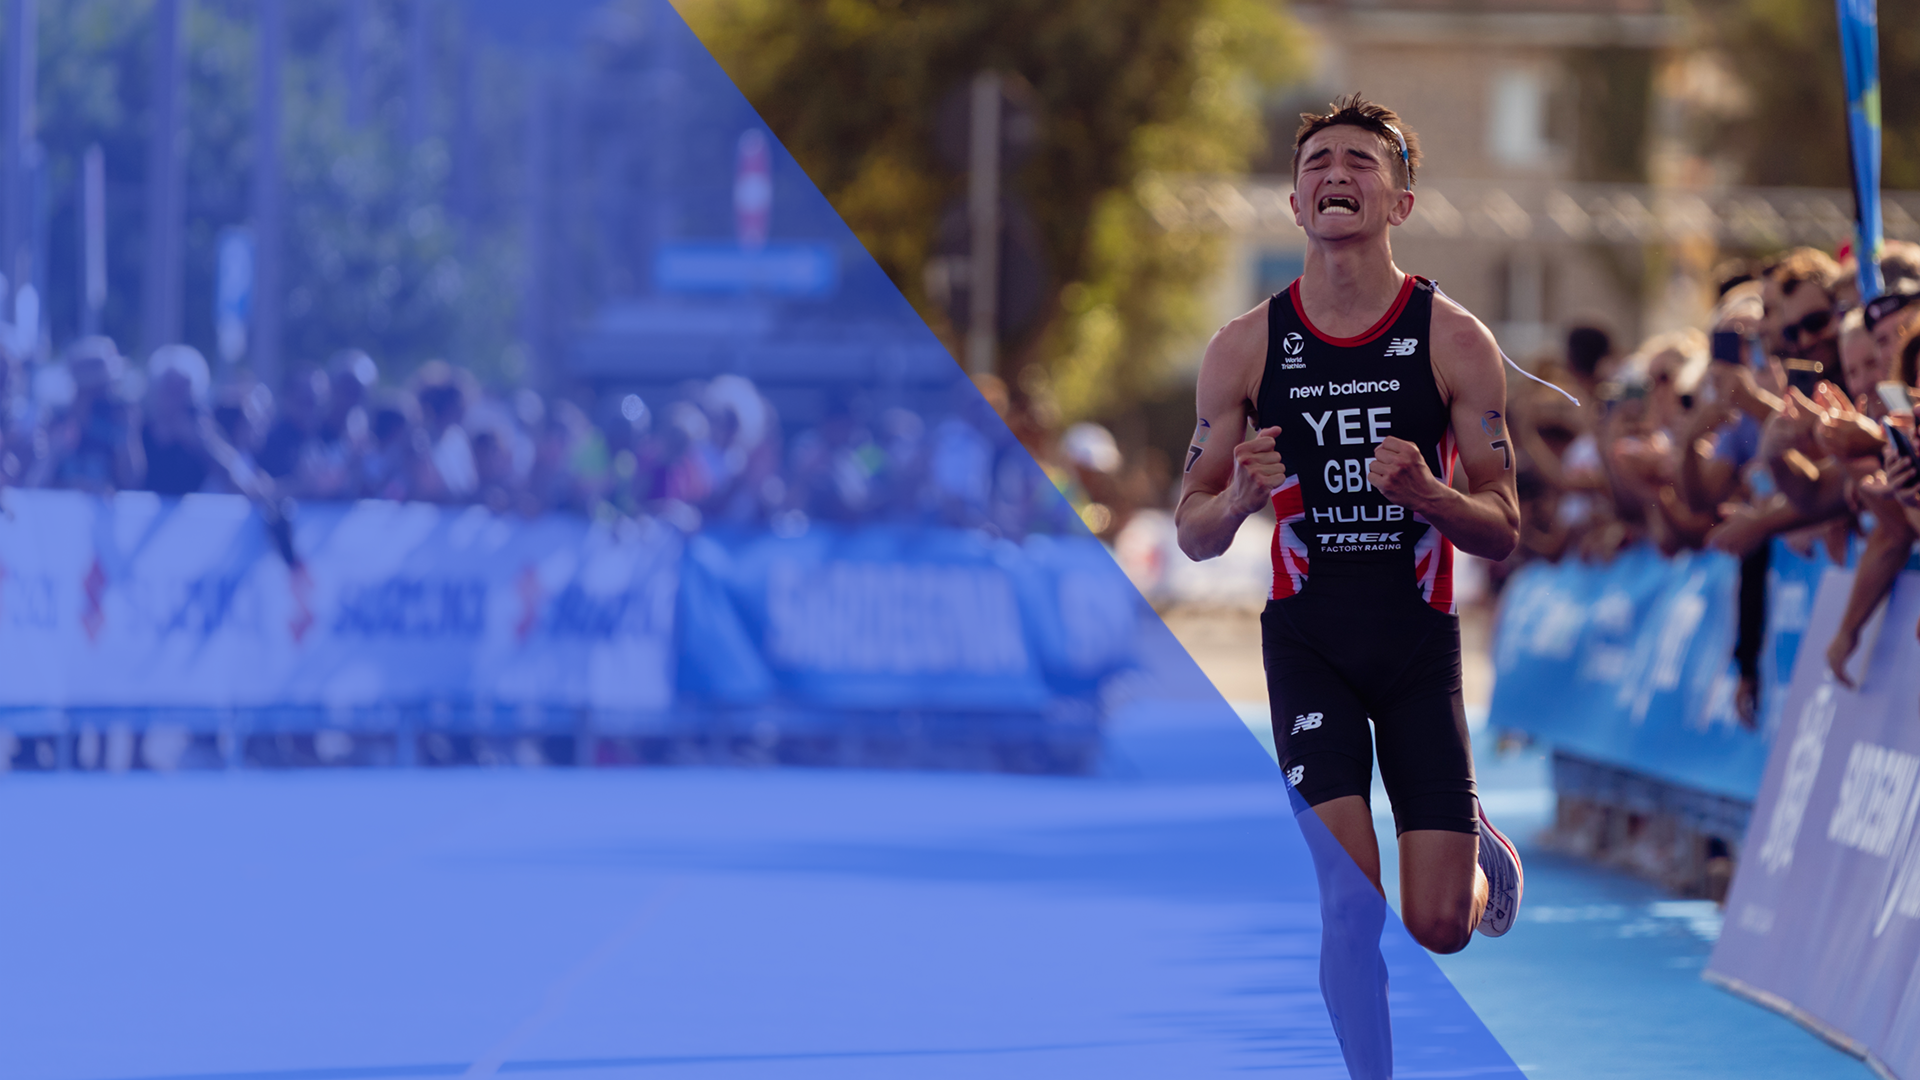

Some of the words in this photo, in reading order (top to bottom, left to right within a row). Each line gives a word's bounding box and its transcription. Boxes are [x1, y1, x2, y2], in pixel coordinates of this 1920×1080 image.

[1290, 385, 1324, 399] new
[1328, 379, 1400, 396] balance
[1301, 407, 1391, 446] YEE
[1185, 444, 1204, 473] 7
[1490, 439, 1511, 470] 7
[1312, 504, 1404, 523] HUUB
[1316, 531, 1404, 544] TREK
[1365, 543, 1401, 551] RACING
